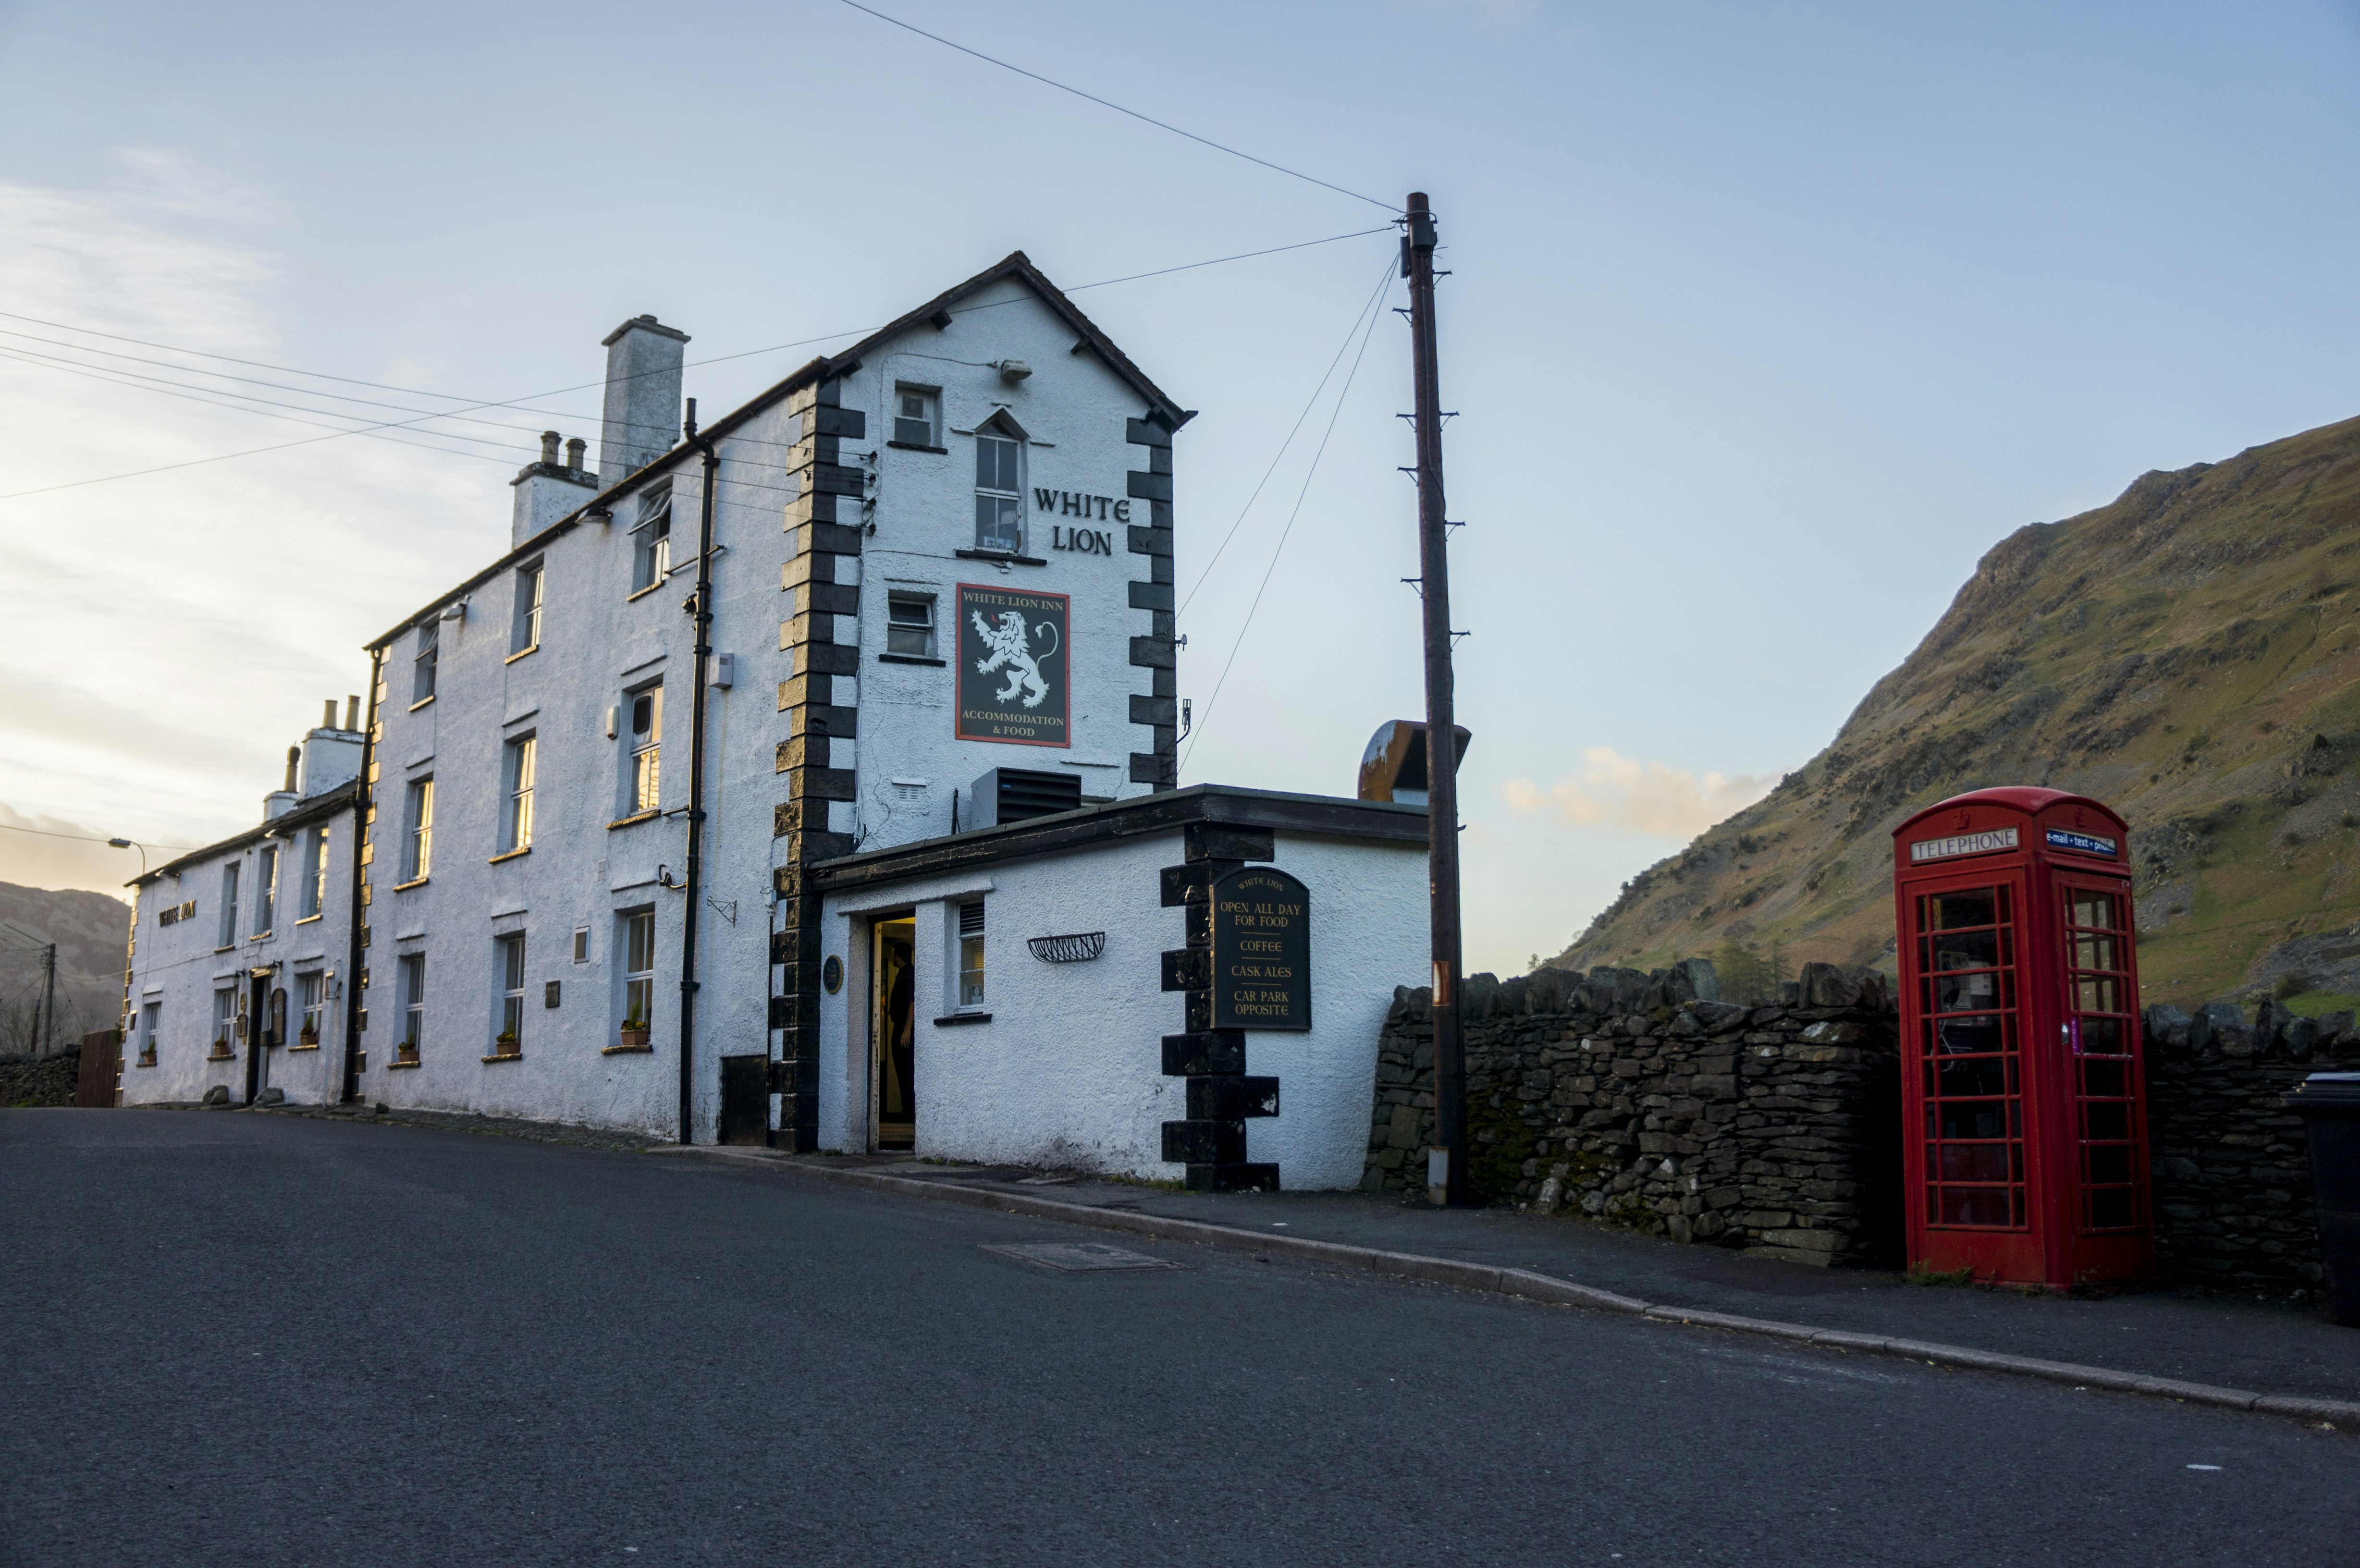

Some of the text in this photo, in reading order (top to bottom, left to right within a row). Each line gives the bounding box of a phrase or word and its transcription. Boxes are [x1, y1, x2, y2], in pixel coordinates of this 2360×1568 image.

[1034, 488, 1130, 523] WHITE
[1053, 526, 1112, 556] LION
[963, 591, 1064, 612] WHITE LION INN
[962, 710, 1064, 726] ACCOMMODATION
[993, 725, 1035, 736] & FOOD
[1915, 830, 2014, 858] TELEPHONE
[2046, 833, 2068, 844] e-mail
[2074, 836, 2089, 847] text
[1238, 877, 1284, 892] WHITE LION
[159, 899, 196, 928] WHITE LION
[1220, 901, 1301, 915] OPEN ALL DAY
[1235, 915, 1289, 927] FOR FOOD
[1240, 940, 1282, 952] COFFEE
[1231, 965, 1291, 978] CASK ALES
[1234, 991, 1289, 1002] CAR PARK
[1235, 1004, 1288, 1016] OPPOSITE
